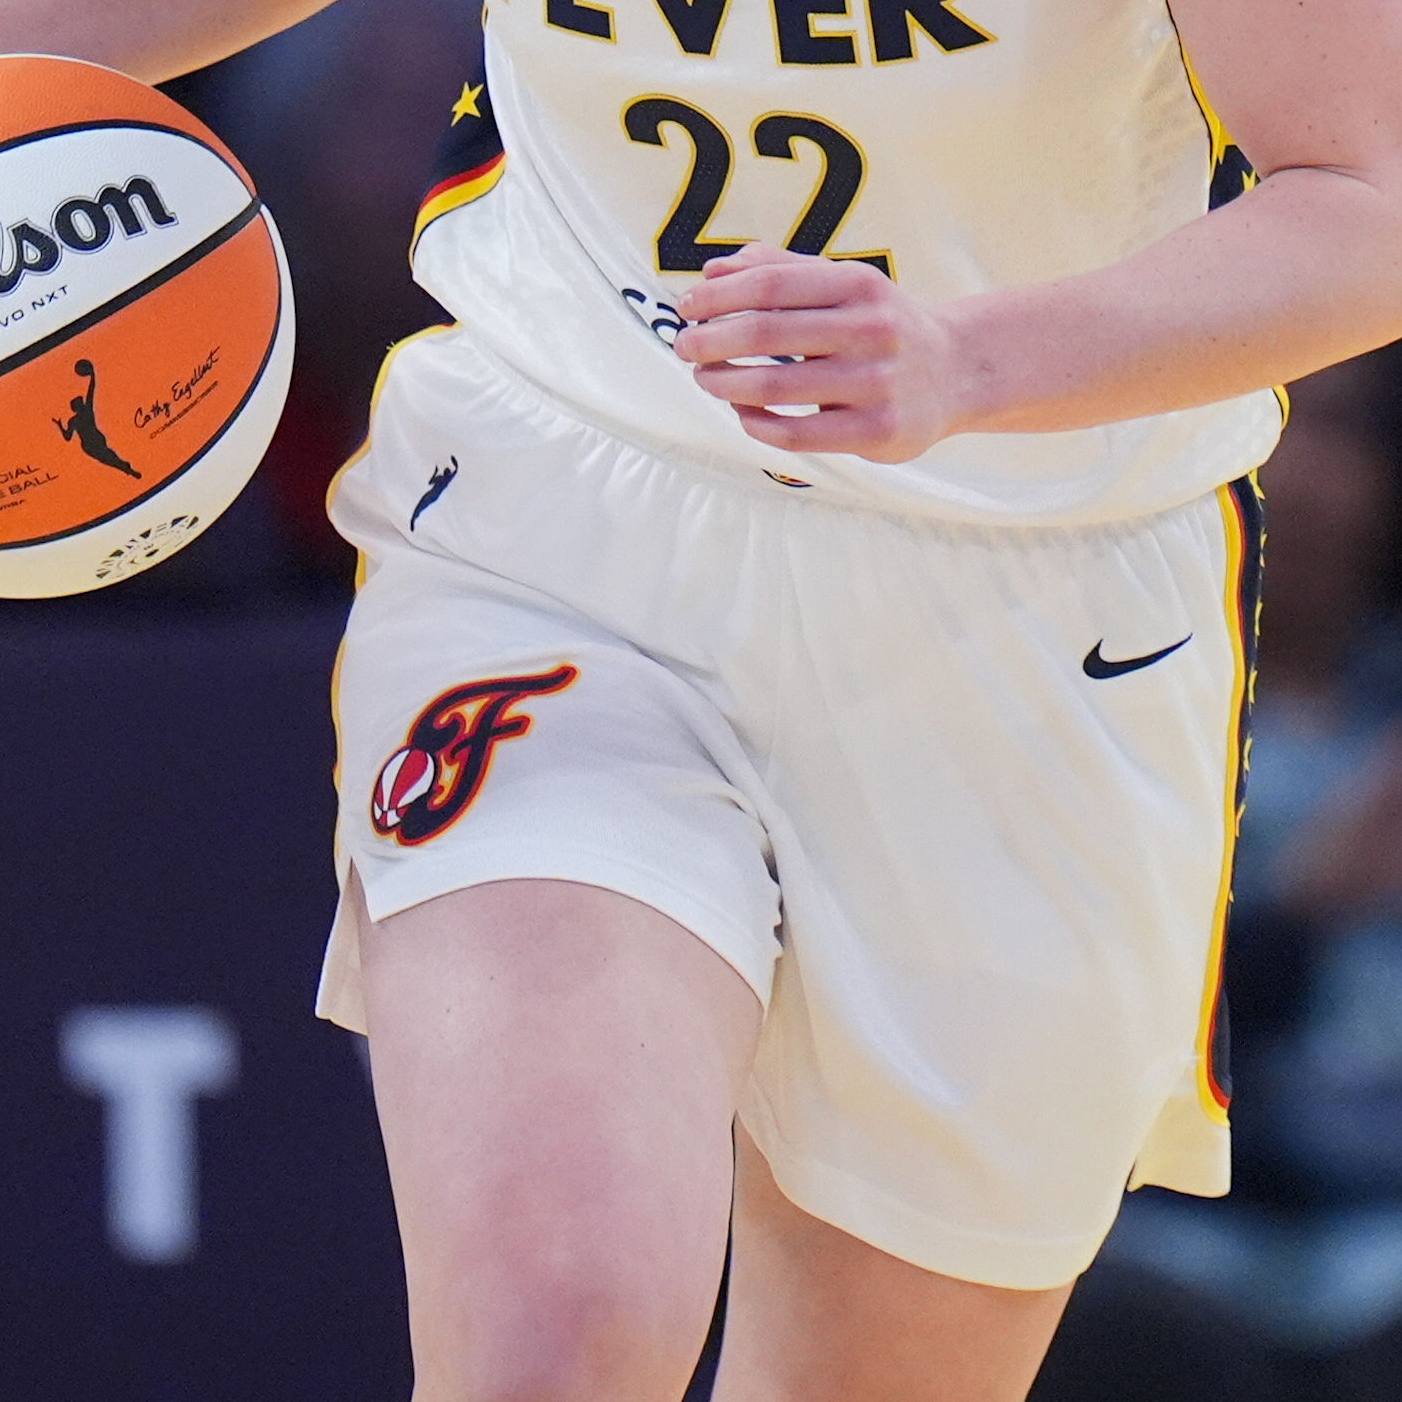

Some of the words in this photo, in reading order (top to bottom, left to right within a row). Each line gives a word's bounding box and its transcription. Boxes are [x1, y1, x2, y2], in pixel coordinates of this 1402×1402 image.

[619, 92, 897, 280] 22
[31, 284, 68, 311] NXT
[9, 472, 59, 496] BALL
